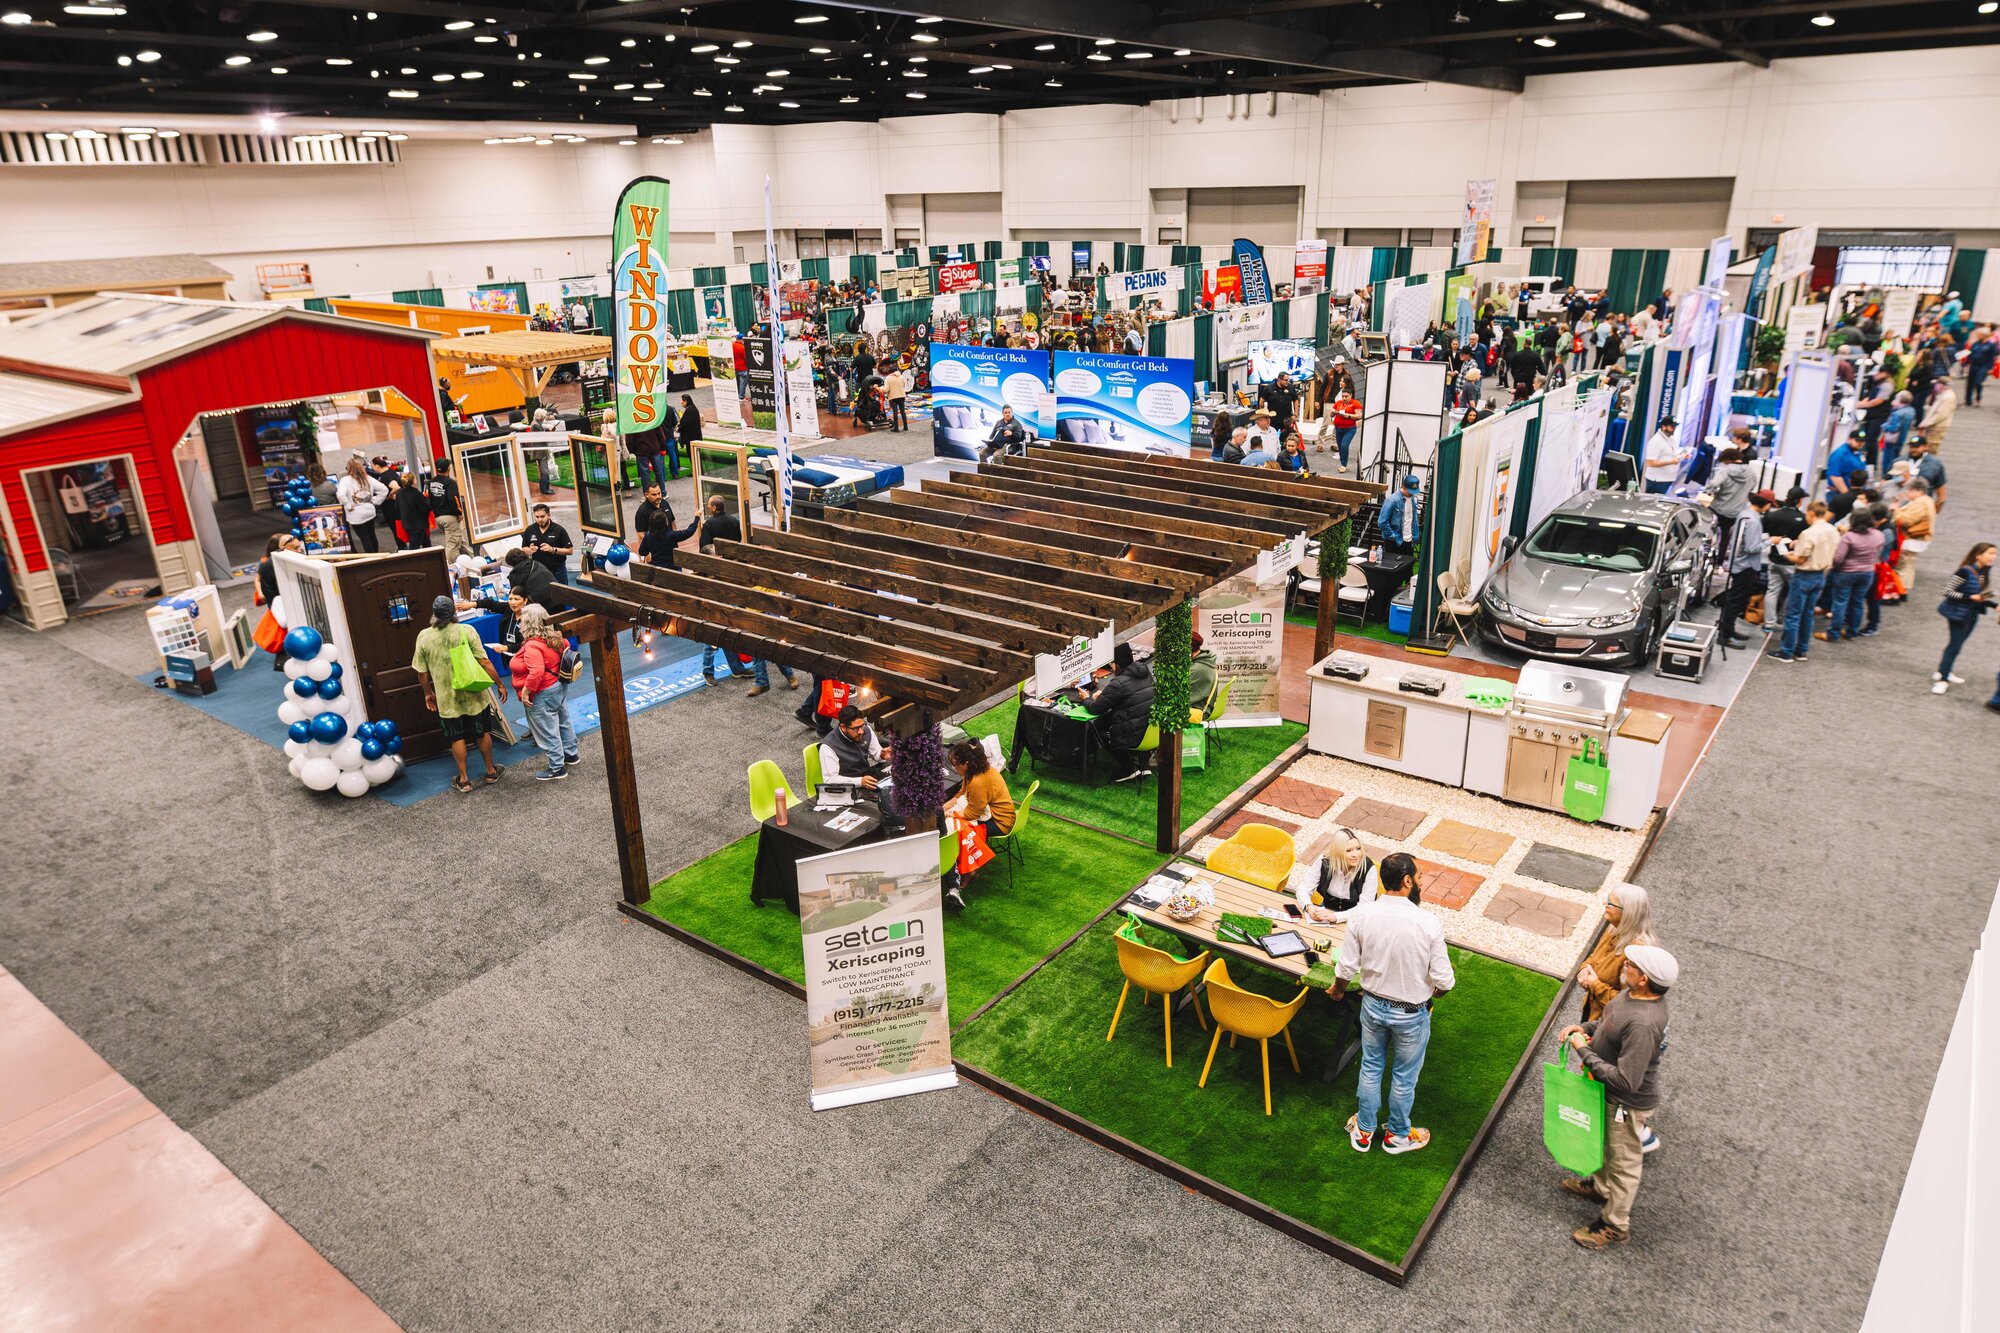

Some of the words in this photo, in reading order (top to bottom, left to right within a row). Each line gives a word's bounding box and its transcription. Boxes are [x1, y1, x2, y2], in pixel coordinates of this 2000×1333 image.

[1124, 272, 1166, 291] PECANS
[1239, 253, 1256, 297] Electric
[628, 204, 661, 424] WINDOWS
[948, 350, 964, 358] Cool
[966, 350, 994, 360] Comfort
[996, 353, 1008, 362] Gel
[1010, 354, 1027, 363] Beds
[1076, 357, 1095, 367] Cool
[1097, 358, 1130, 370] Comfort
[1132, 361, 1146, 371] Gel
[1148, 362, 1168, 372] Beds
[1212, 611, 1272, 624] setcon
[1212, 628, 1272, 638] Xeriscaping
[1061, 653, 1092, 674] Xeriscaping
[825, 919, 924, 952] setcon
[828, 946, 925, 972] Xeriscaping
[822, 975, 847, 986] Switch
[858, 966, 902, 979] Xeriscaping
[904, 960, 932, 970] TODAY!
[838, 980, 858, 990] LOW
[860, 970, 916, 986] MAINTENANCE
[849, 980, 905, 995] LANDSCAPING
[834, 1007, 864, 1022] (915)
[868, 996, 924, 1015] 777-2215
[832, 1033, 844, 1041] 0%
[846, 1028, 874, 1038] interest
[900, 1020, 928, 1029] months
[840, 1018, 880, 1030] Financing
[855, 1043, 871, 1052] Our
[873, 1038, 908, 1049] services:
[856, 1051, 874, 1059] Grass
[913, 1040, 940, 1048] concrete
[866, 1054, 895, 1062] Concrete
